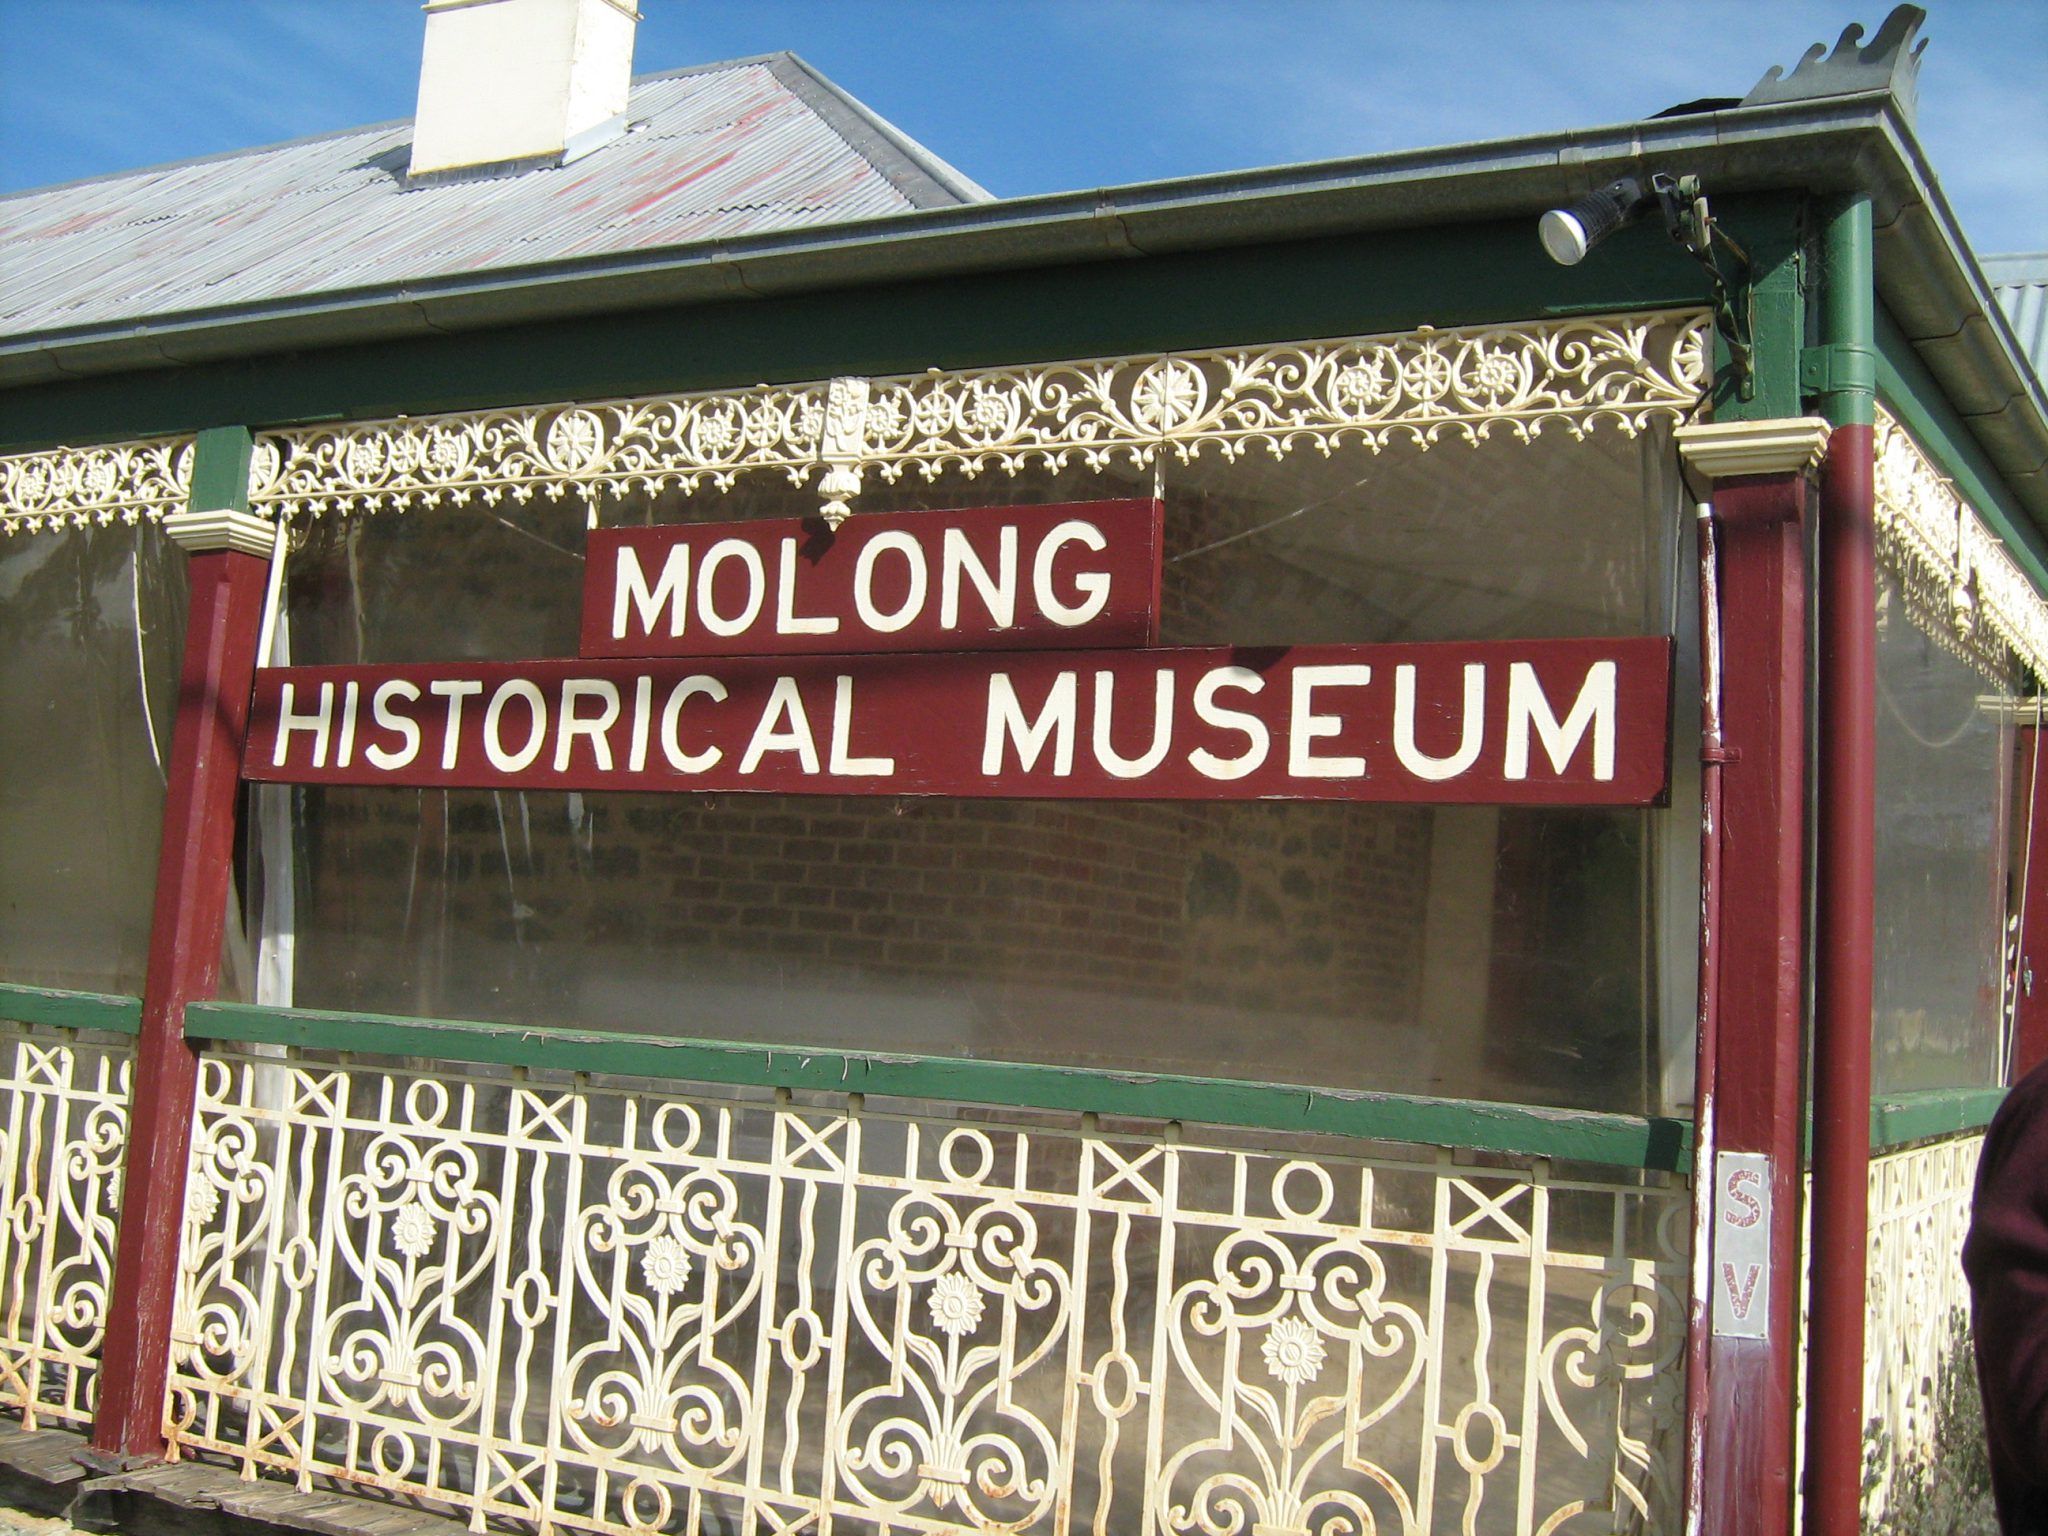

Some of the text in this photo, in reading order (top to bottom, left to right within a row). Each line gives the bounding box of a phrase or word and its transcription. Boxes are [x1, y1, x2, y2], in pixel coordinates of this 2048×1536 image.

[610, 519, 1113, 641] MOLONG
[271, 659, 1618, 782] HISTORICAL MUSEUM
